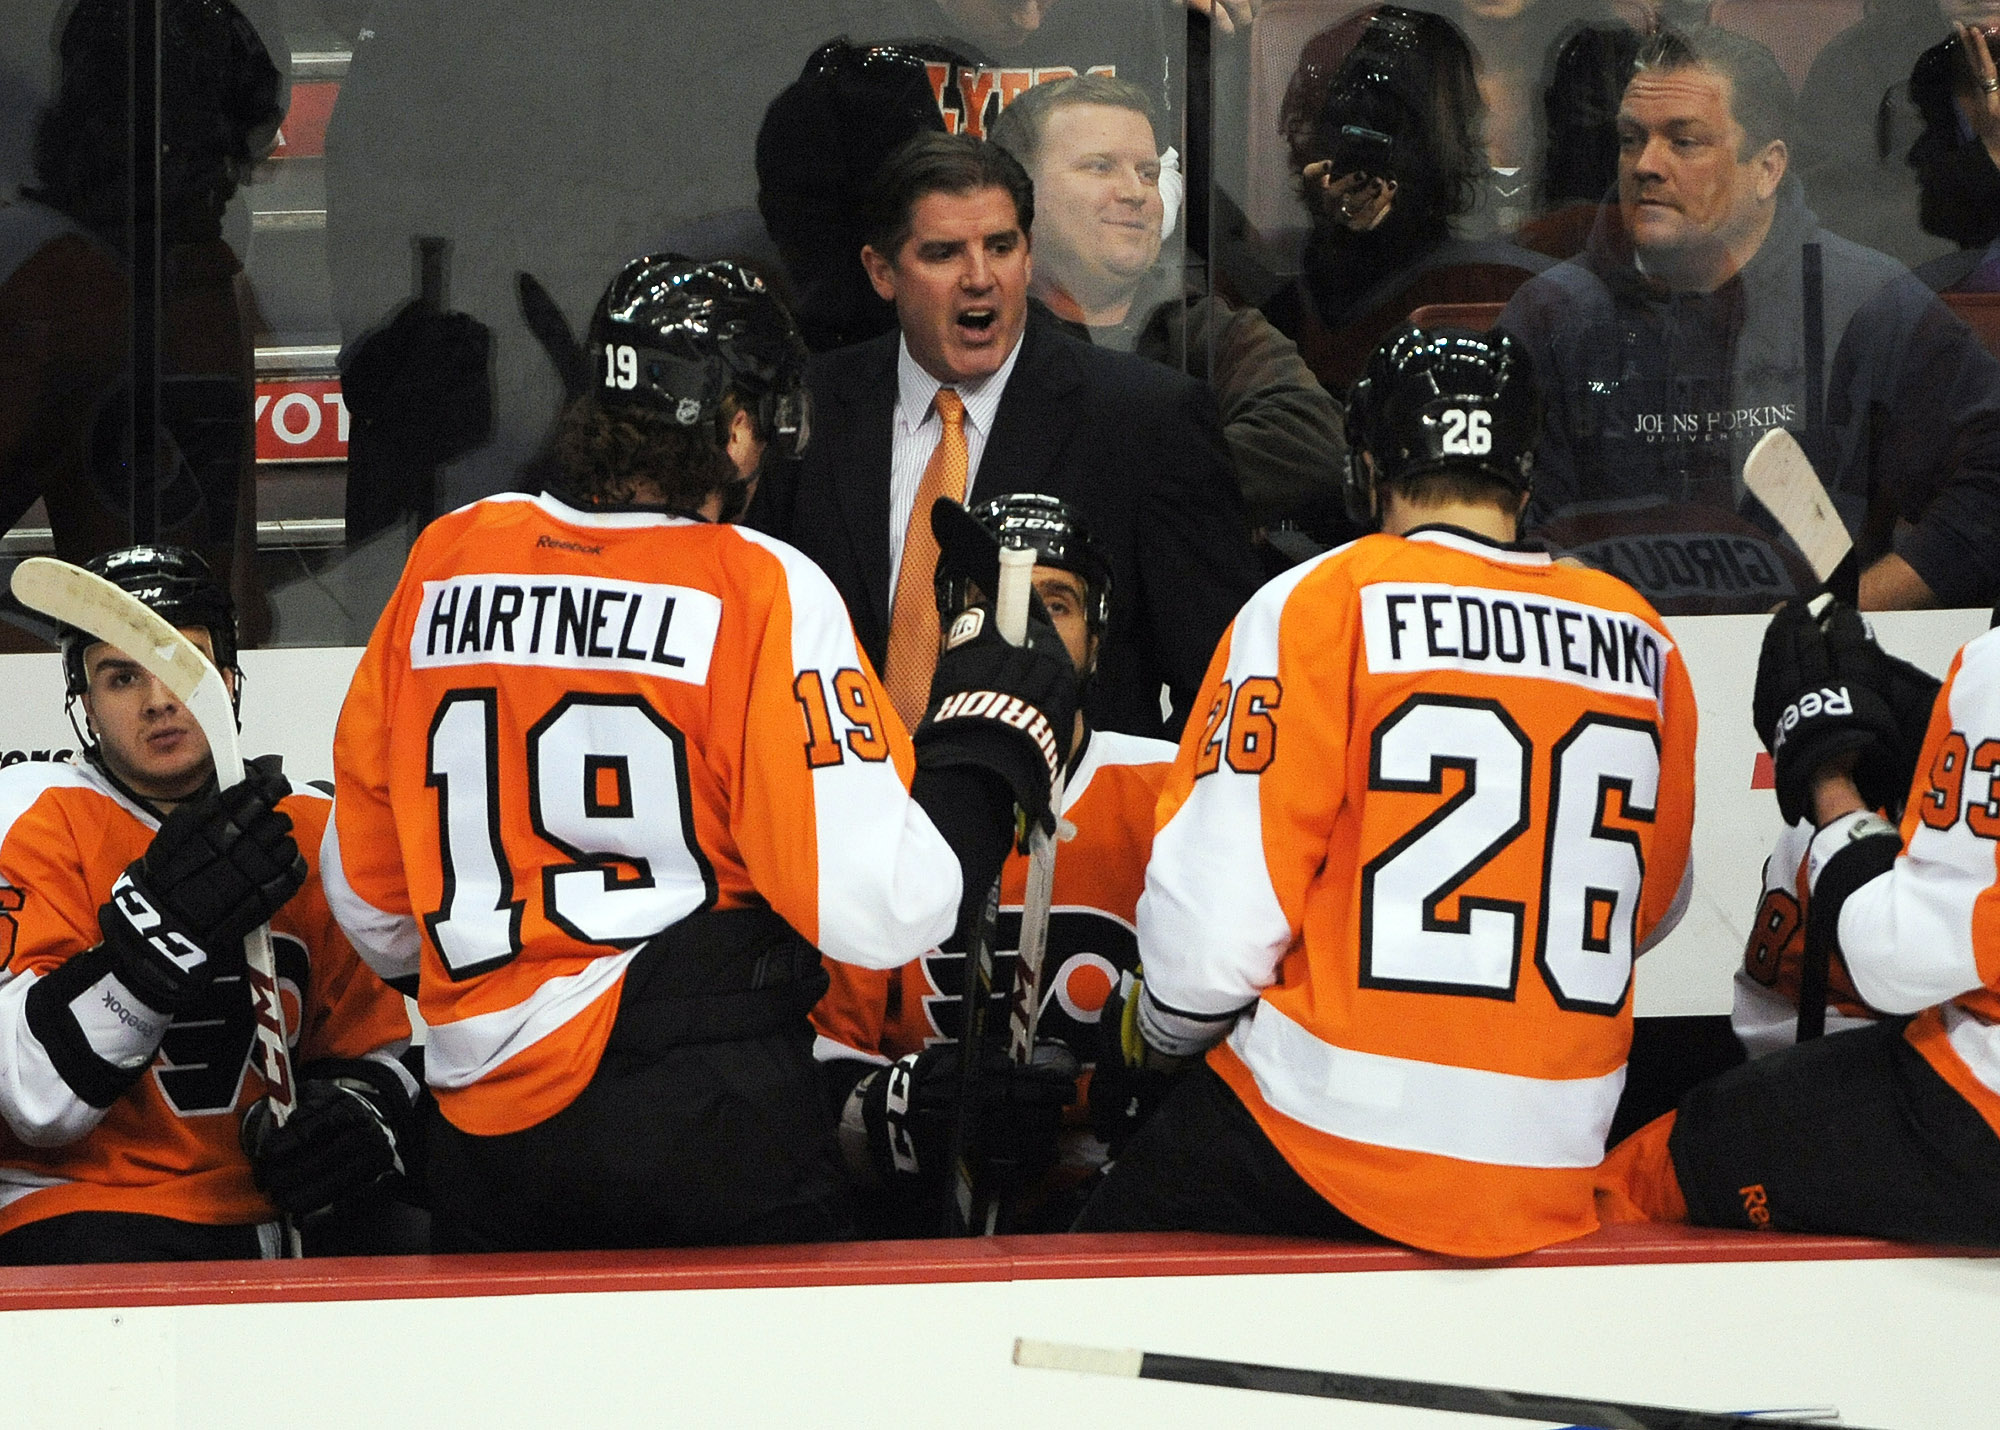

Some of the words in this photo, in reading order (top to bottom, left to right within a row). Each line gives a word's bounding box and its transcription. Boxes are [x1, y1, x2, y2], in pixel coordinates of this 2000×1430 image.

[605, 343, 638, 390] 19
[1442, 408, 1492, 455] 26
[1635, 413, 1699, 433] JOHNS
[1707, 404, 1796, 432] HOPKINS
[536, 535, 604, 555] Reebok
[1005, 517, 1065, 532] CCM
[426, 585, 687, 668] HARTNELL
[1386, 594, 1660, 697] FEDOTENKO
[792, 666, 890, 770] 19
[1194, 675, 1284, 780] 26
[423, 686, 719, 982] 19
[1919, 730, 2000, 841] 93
[1358, 692, 1662, 1017] 26
[1745, 887, 1802, 988] 8
